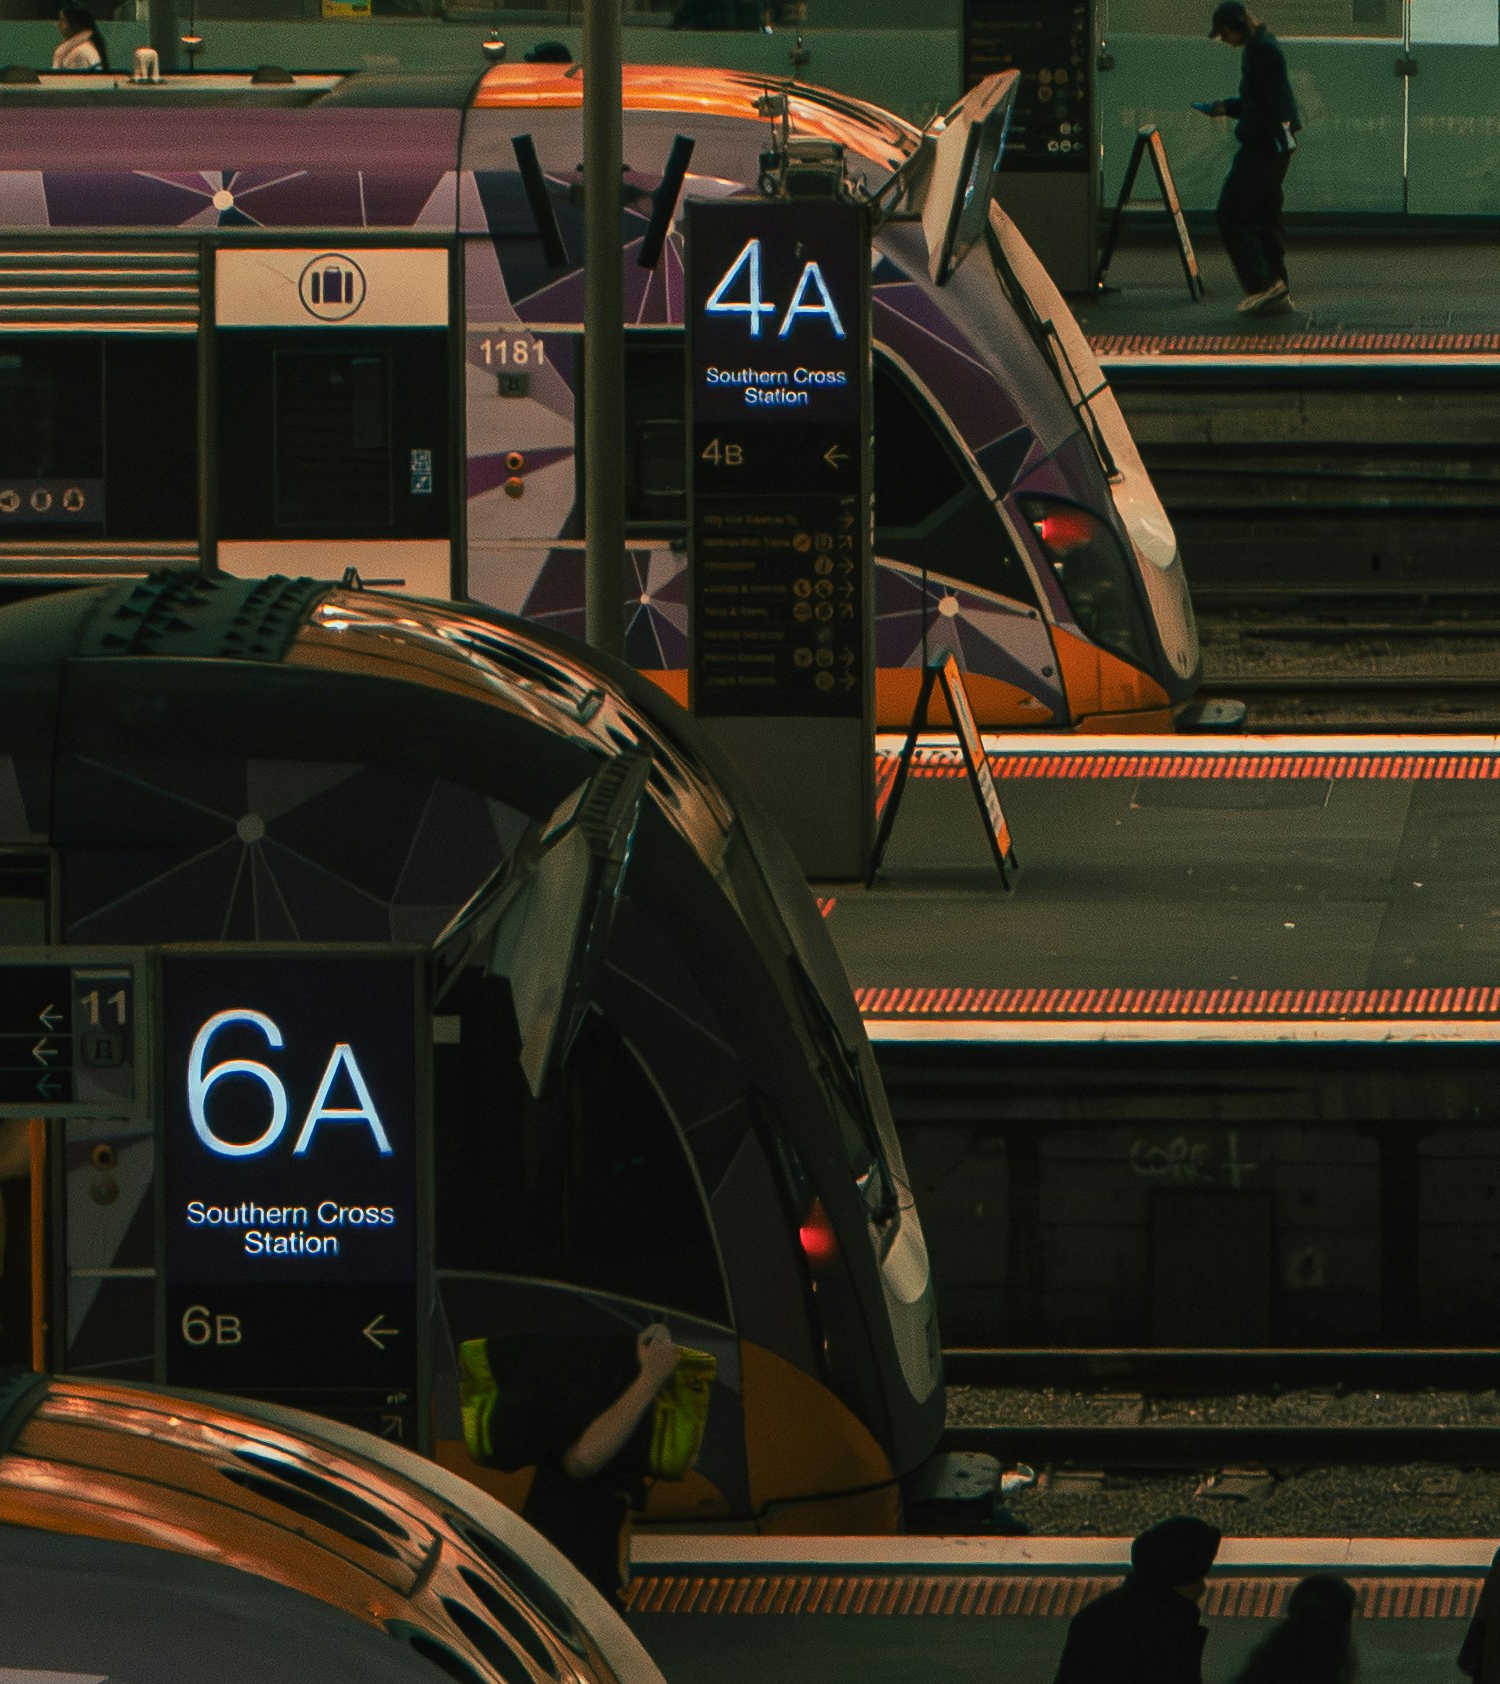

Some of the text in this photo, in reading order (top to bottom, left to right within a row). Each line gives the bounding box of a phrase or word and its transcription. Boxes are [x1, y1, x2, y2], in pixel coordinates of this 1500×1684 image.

[705, 236, 846, 340] 4A
[479, 338, 545, 366] 1181
[706, 366, 847, 384] Southern Cross
[745, 387, 809, 404] Station
[701, 438, 745, 466] 4B
[187, 1008, 394, 1160] 6A
[186, 1201, 396, 1225] Southern Cross
[244, 1230, 340, 1255] Station
[180, 1304, 243, 1345] 6B
